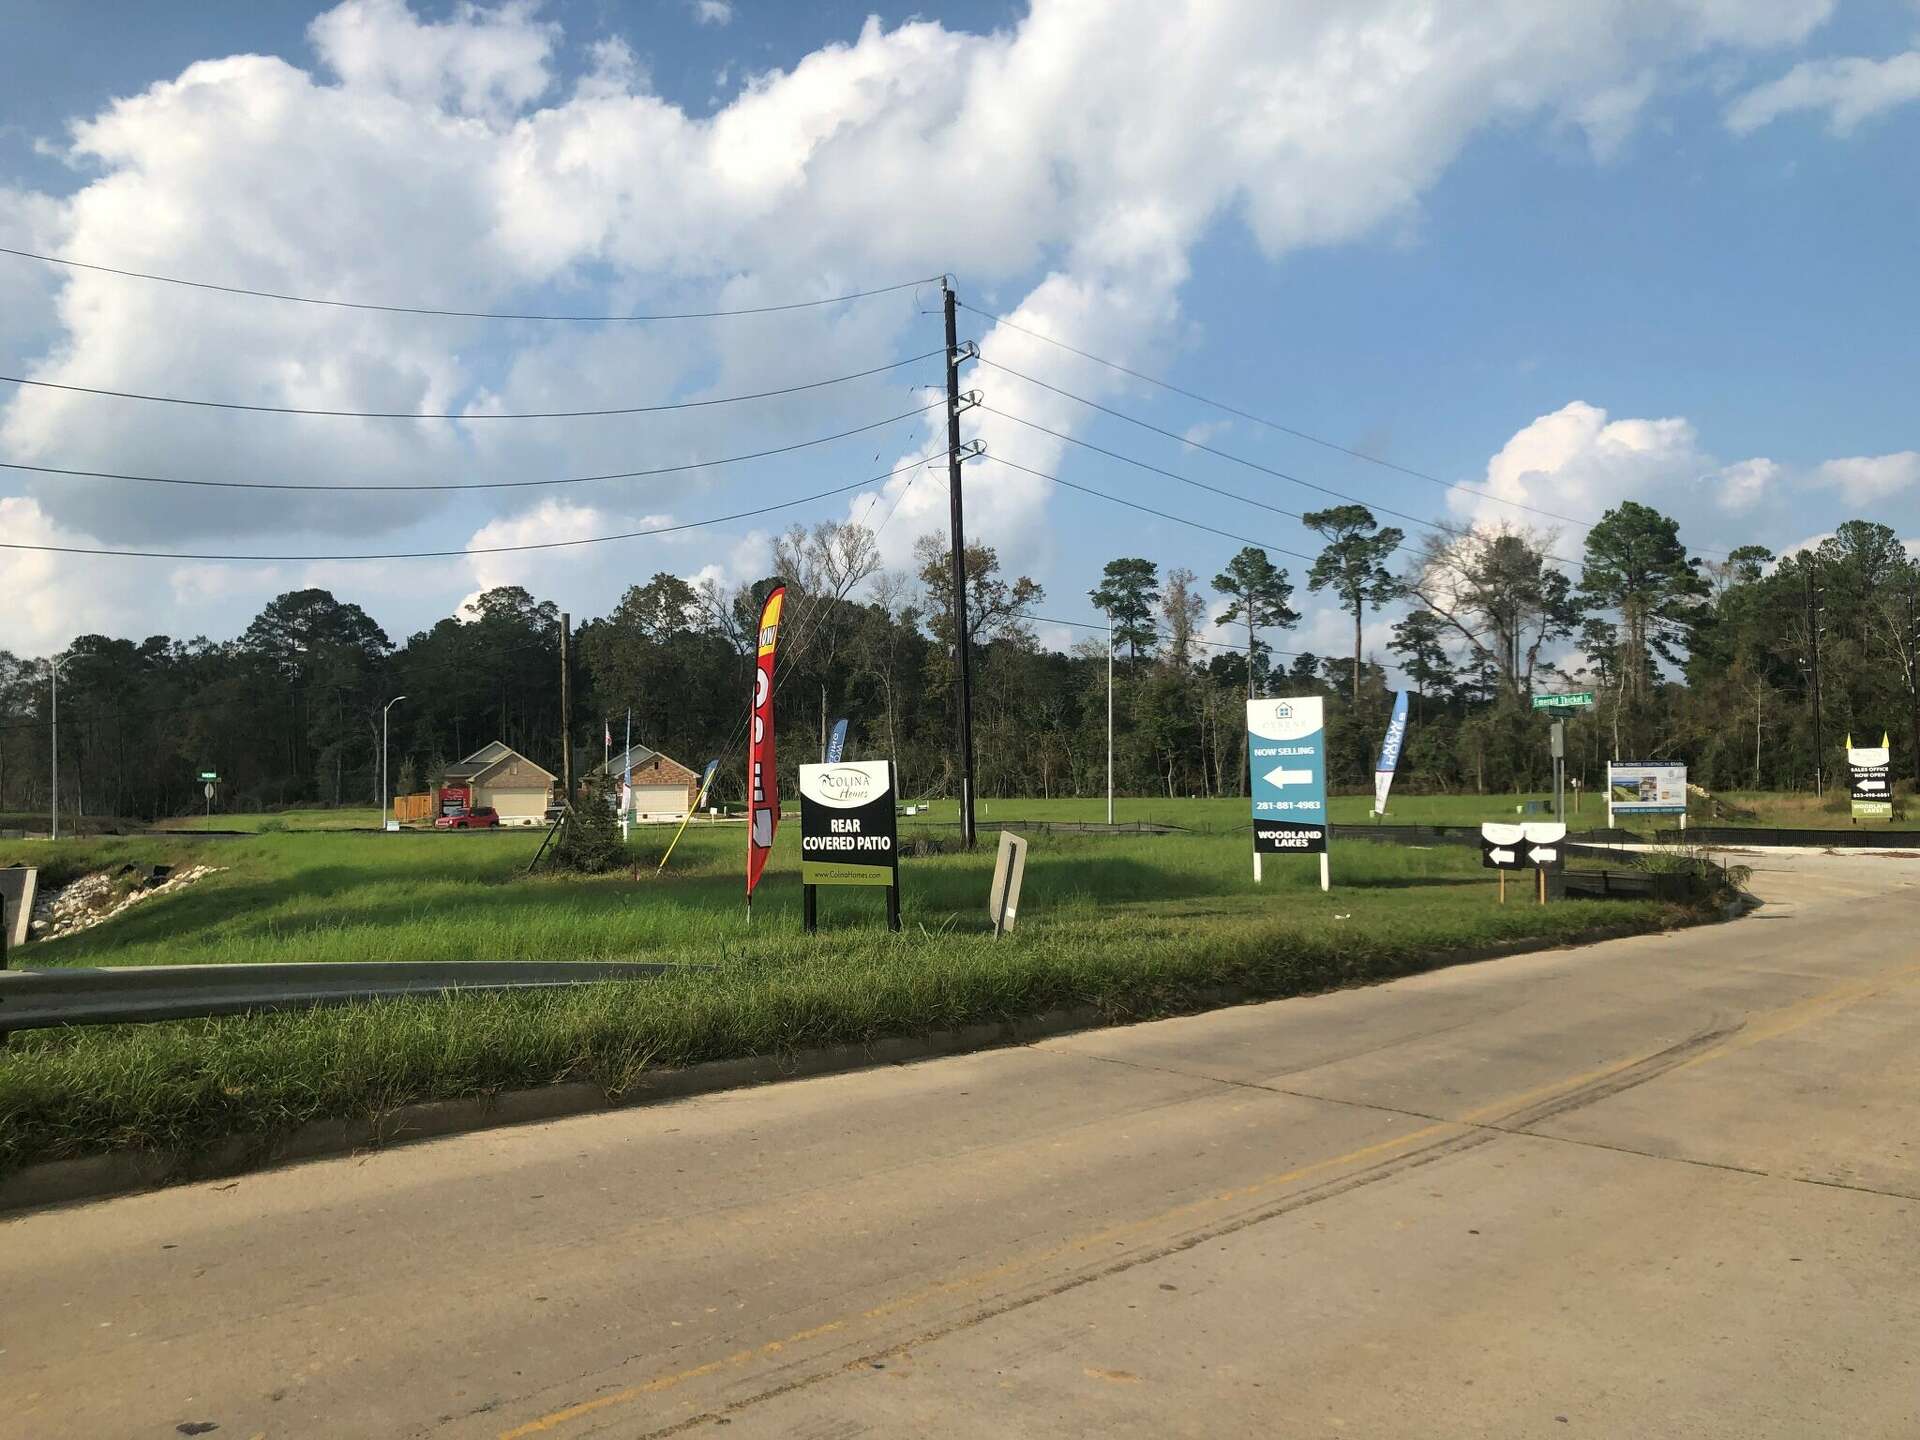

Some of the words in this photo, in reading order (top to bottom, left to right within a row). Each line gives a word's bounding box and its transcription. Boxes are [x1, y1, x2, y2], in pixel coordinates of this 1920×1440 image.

[758, 625, 777, 649] OW
[1382, 720, 1399, 754] NEW
[1254, 748, 1276, 756] NOW
[1278, 746, 1315, 756] SELLING
[829, 776, 870, 787] COLINA
[1256, 801, 1321, 810] 281-881-4983
[831, 819, 861, 833] REAR
[1258, 830, 1322, 839] WOODLAND
[803, 836, 855, 850] COVERED
[857, 836, 891, 850] PATIO
[1274, 839, 1309, 847] LAKES
[814, 869, 881, 879] www.ColinaHomes.com
